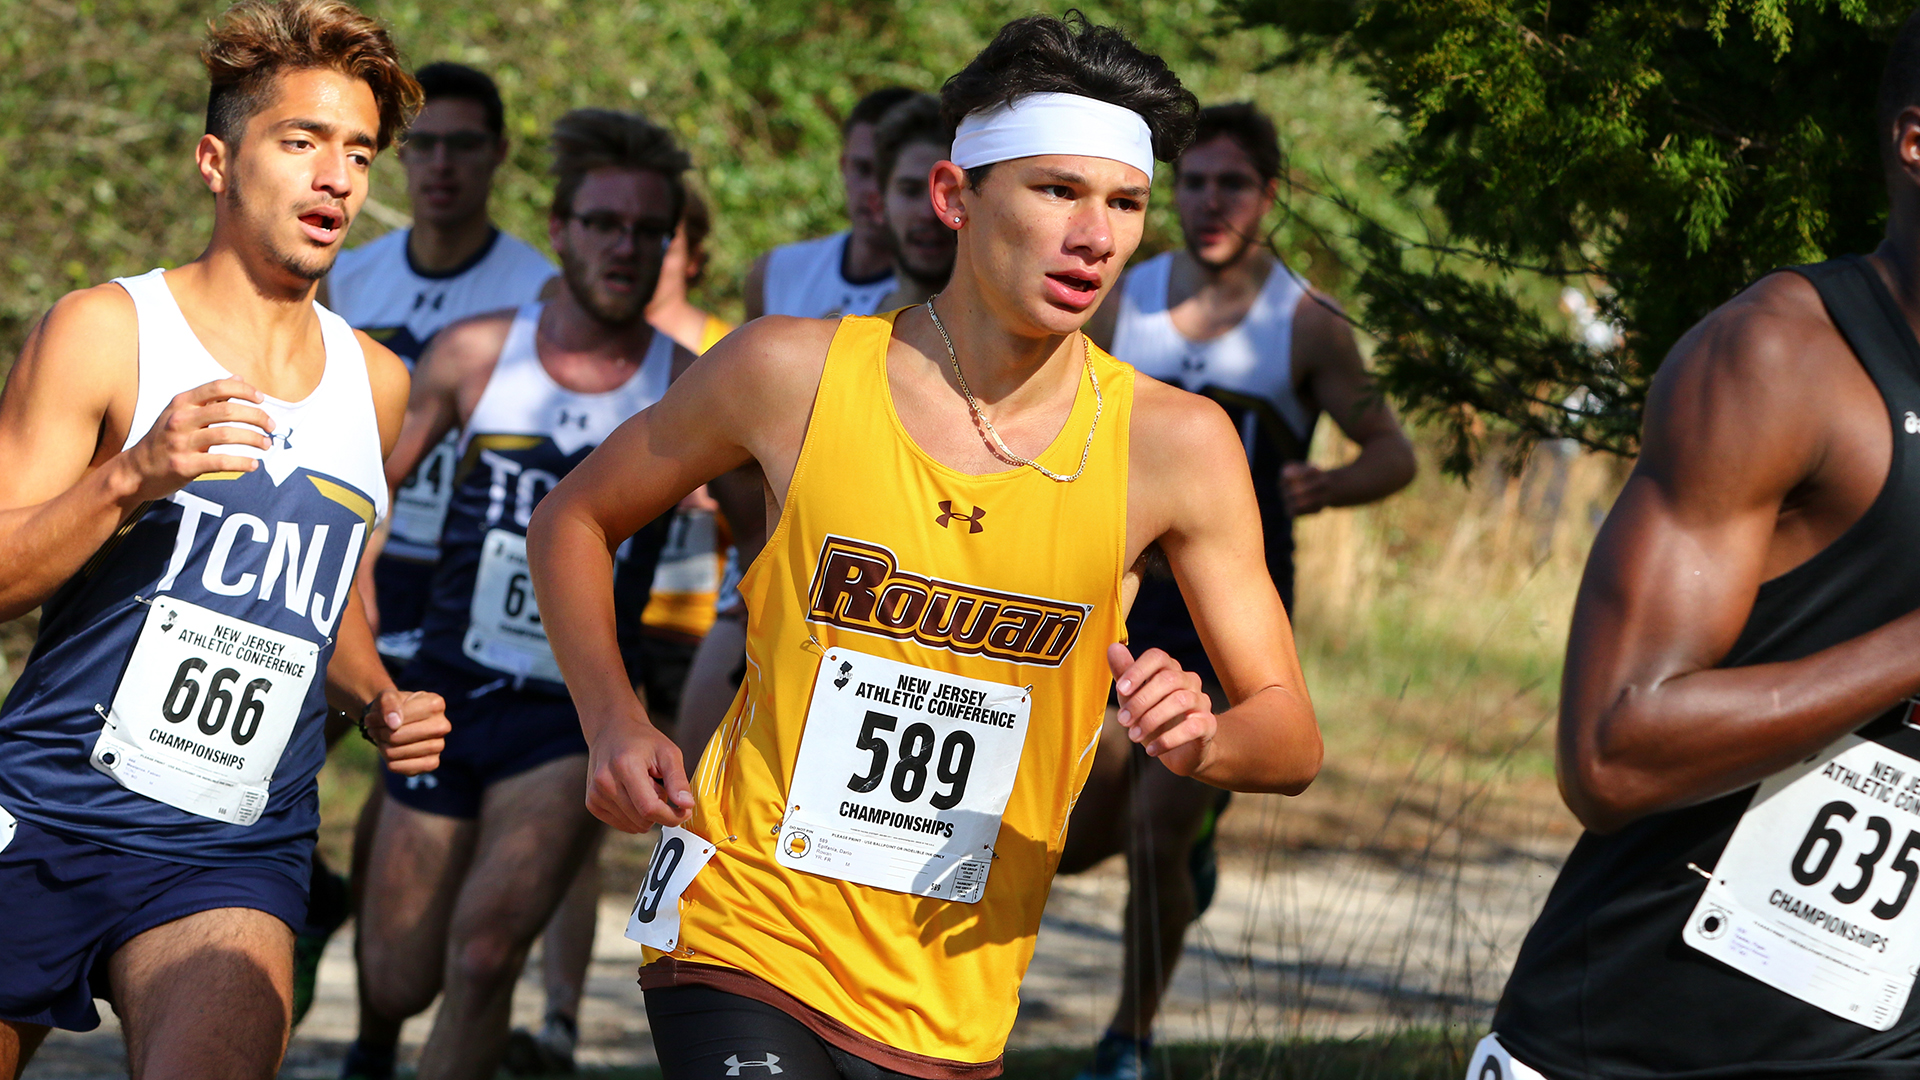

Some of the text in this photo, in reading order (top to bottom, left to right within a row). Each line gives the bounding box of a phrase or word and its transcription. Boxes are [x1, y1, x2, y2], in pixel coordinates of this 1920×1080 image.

[156, 489, 367, 638] TCNJ
[807, 537, 1090, 665] Rowan
[178, 629, 306, 678] ATHLETIC CONFERENCE
[214, 625, 286, 657] NEW JERSEY
[162, 657, 273, 746] 666
[855, 682, 1017, 729] ATHLETIC CONFERENCE
[897, 674, 987, 707] NEW JERSEY
[149, 728, 246, 770] CHAMPIONSHIPS
[847, 710, 976, 811] 589
[1822, 761, 1893, 803] ATHLETIC
[1870, 761, 1905, 786] NEW
[839, 801, 955, 838] CHAMPIONSHIPS
[873, 841, 896, 850] BALLPOINT
[1791, 800, 1920, 921] 635
[632, 837, 685, 924] 9
[1768, 889, 1890, 953] CHAMPIONSHIPS
